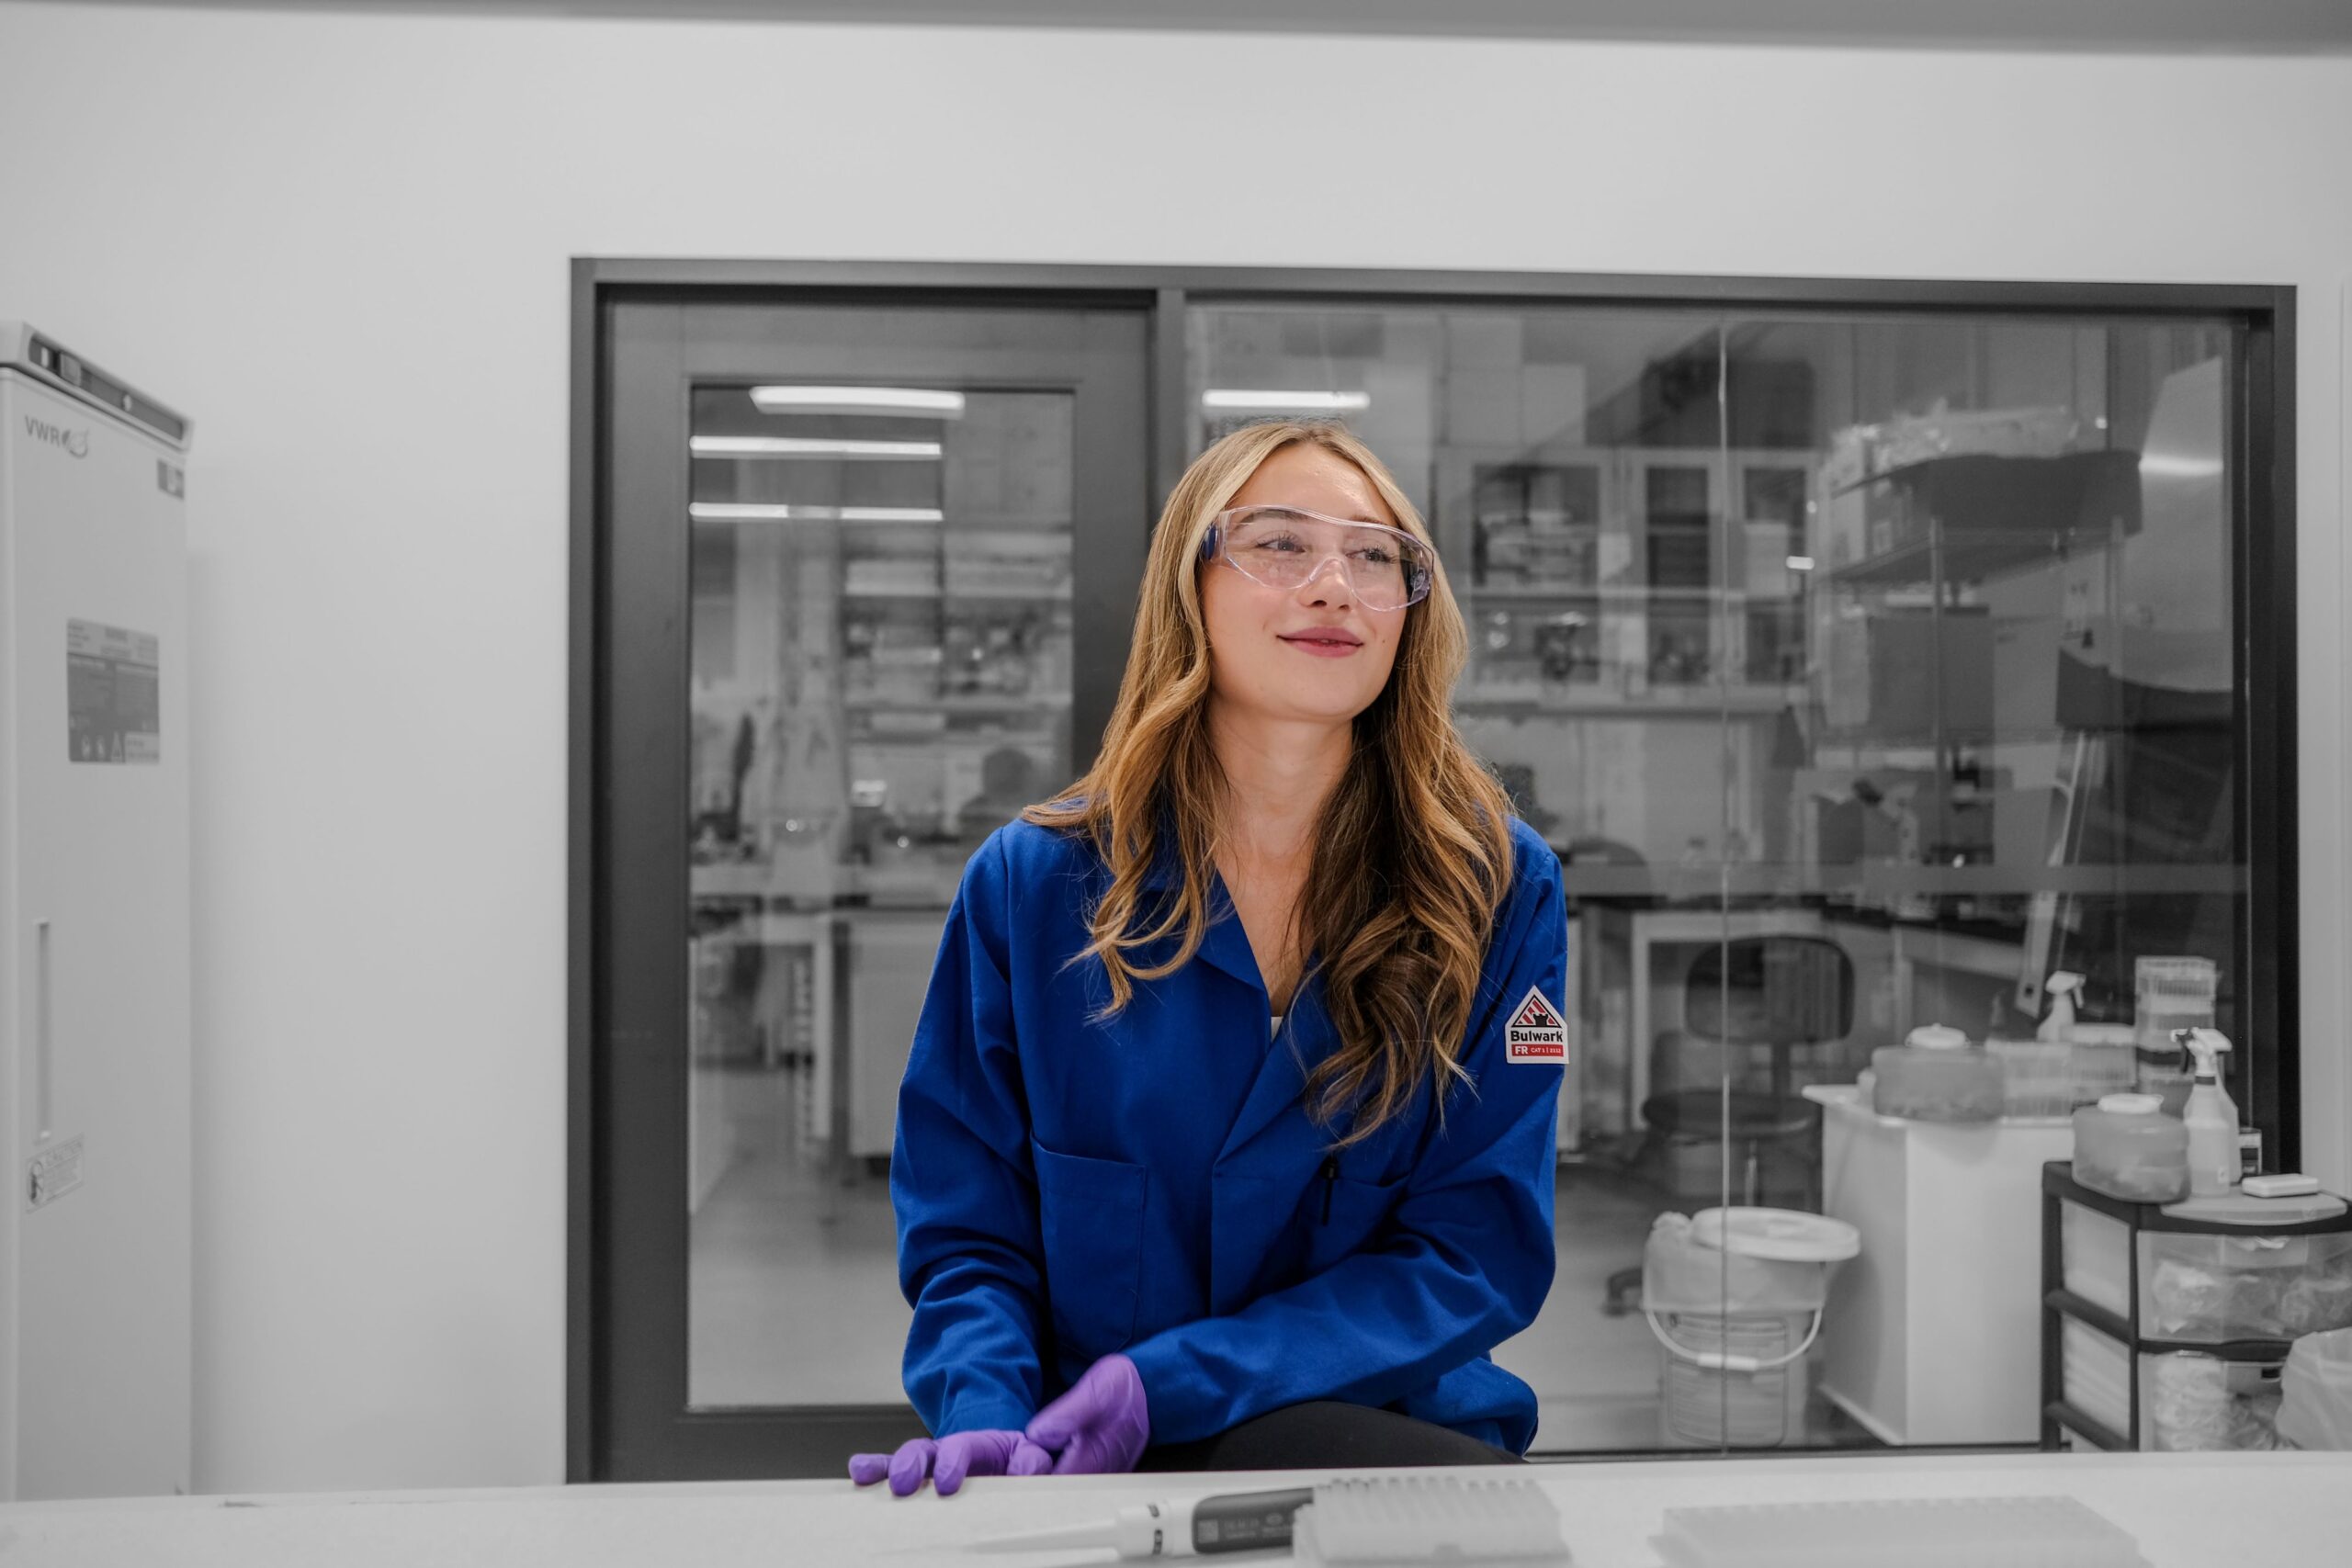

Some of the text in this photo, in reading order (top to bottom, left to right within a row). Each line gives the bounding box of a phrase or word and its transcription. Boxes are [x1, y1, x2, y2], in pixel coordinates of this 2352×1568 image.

[25, 415, 60, 447] VWR
[1510, 1031, 1563, 1043] Bulwark
[1515, 1045, 1529, 1055] FR
